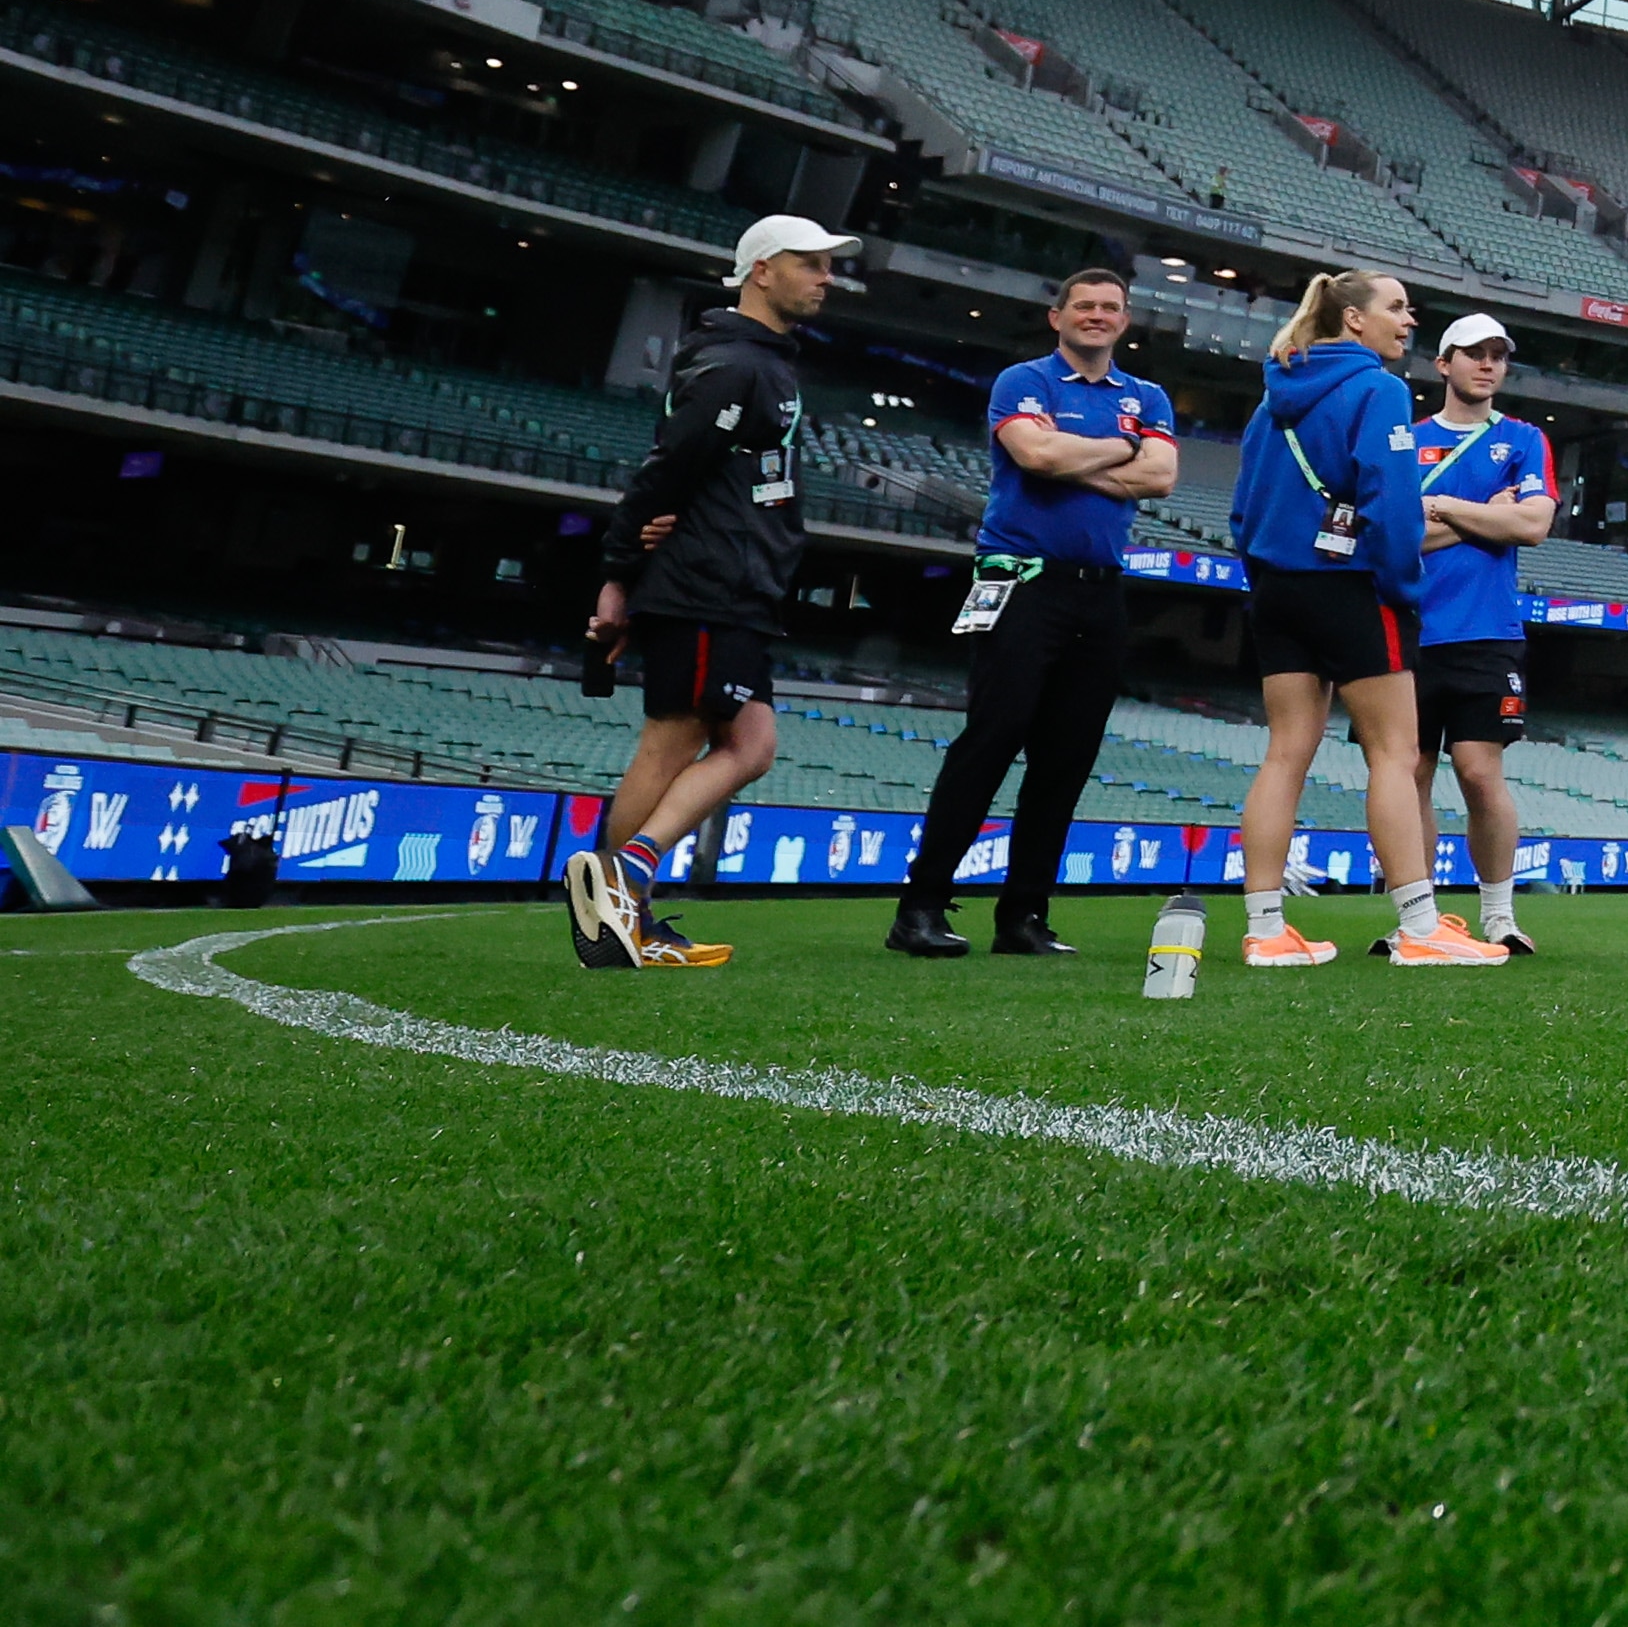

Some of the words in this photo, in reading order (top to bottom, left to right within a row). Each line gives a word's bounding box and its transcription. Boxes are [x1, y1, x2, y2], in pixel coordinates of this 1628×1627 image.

[1129, 552, 1155, 570] WITH
[1155, 551, 1171, 568] US
[1547, 607, 1567, 622] RISE
[1567, 605, 1590, 620] WITH
[1590, 604, 1604, 618] US
[282, 796, 347, 859] WITH
[342, 789, 380, 843] US
[723, 812, 753, 854] US
[1533, 841, 1551, 867] US
